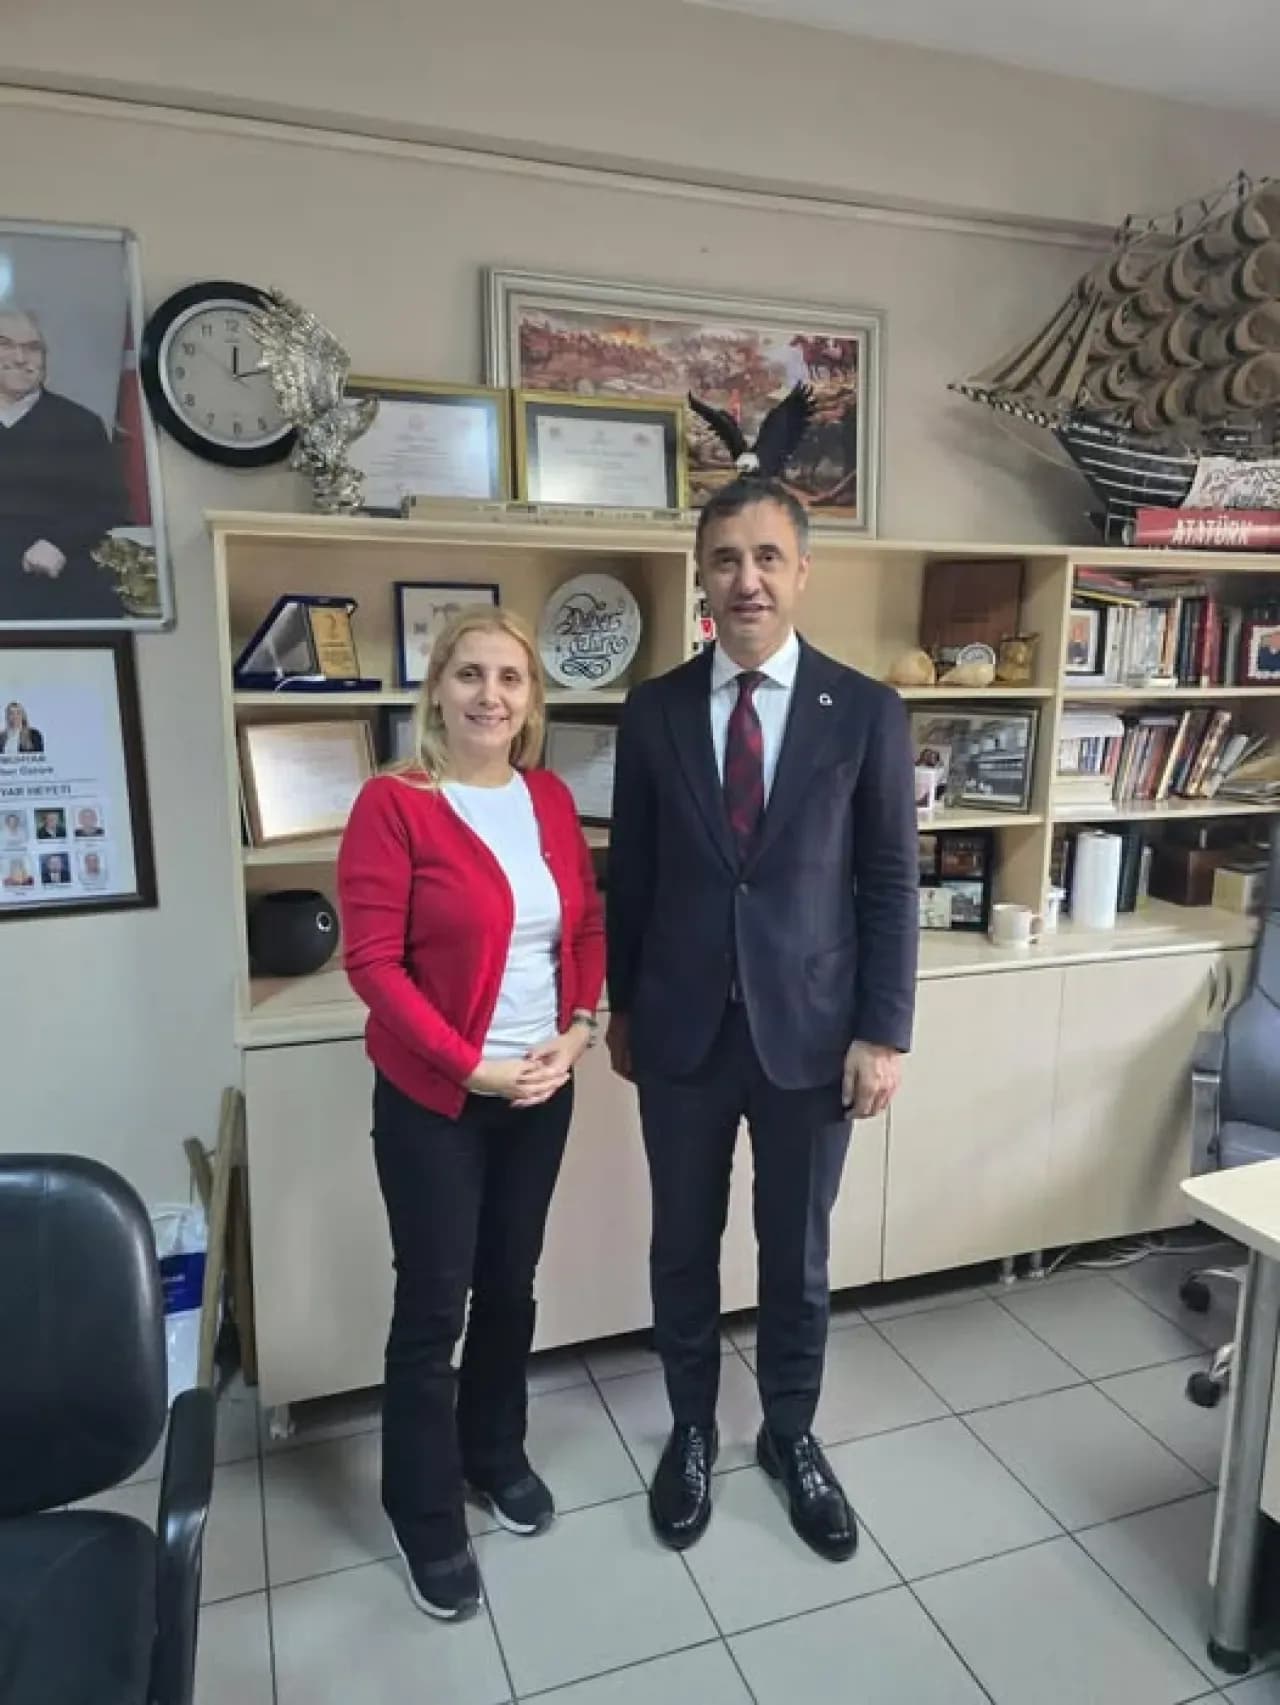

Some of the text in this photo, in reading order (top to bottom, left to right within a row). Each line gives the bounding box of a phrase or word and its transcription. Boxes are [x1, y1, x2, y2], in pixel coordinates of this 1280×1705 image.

[202, 325, 212, 337] 11
[225, 319, 239, 333] 12
[182, 343, 195, 356] 10
[184, 393, 195, 406] 8
[206, 413, 215, 425] 7
[257, 417, 267, 430] 5
[233, 421, 242, 434] 6
[1172, 515, 1251, 545] ATATÜRK
